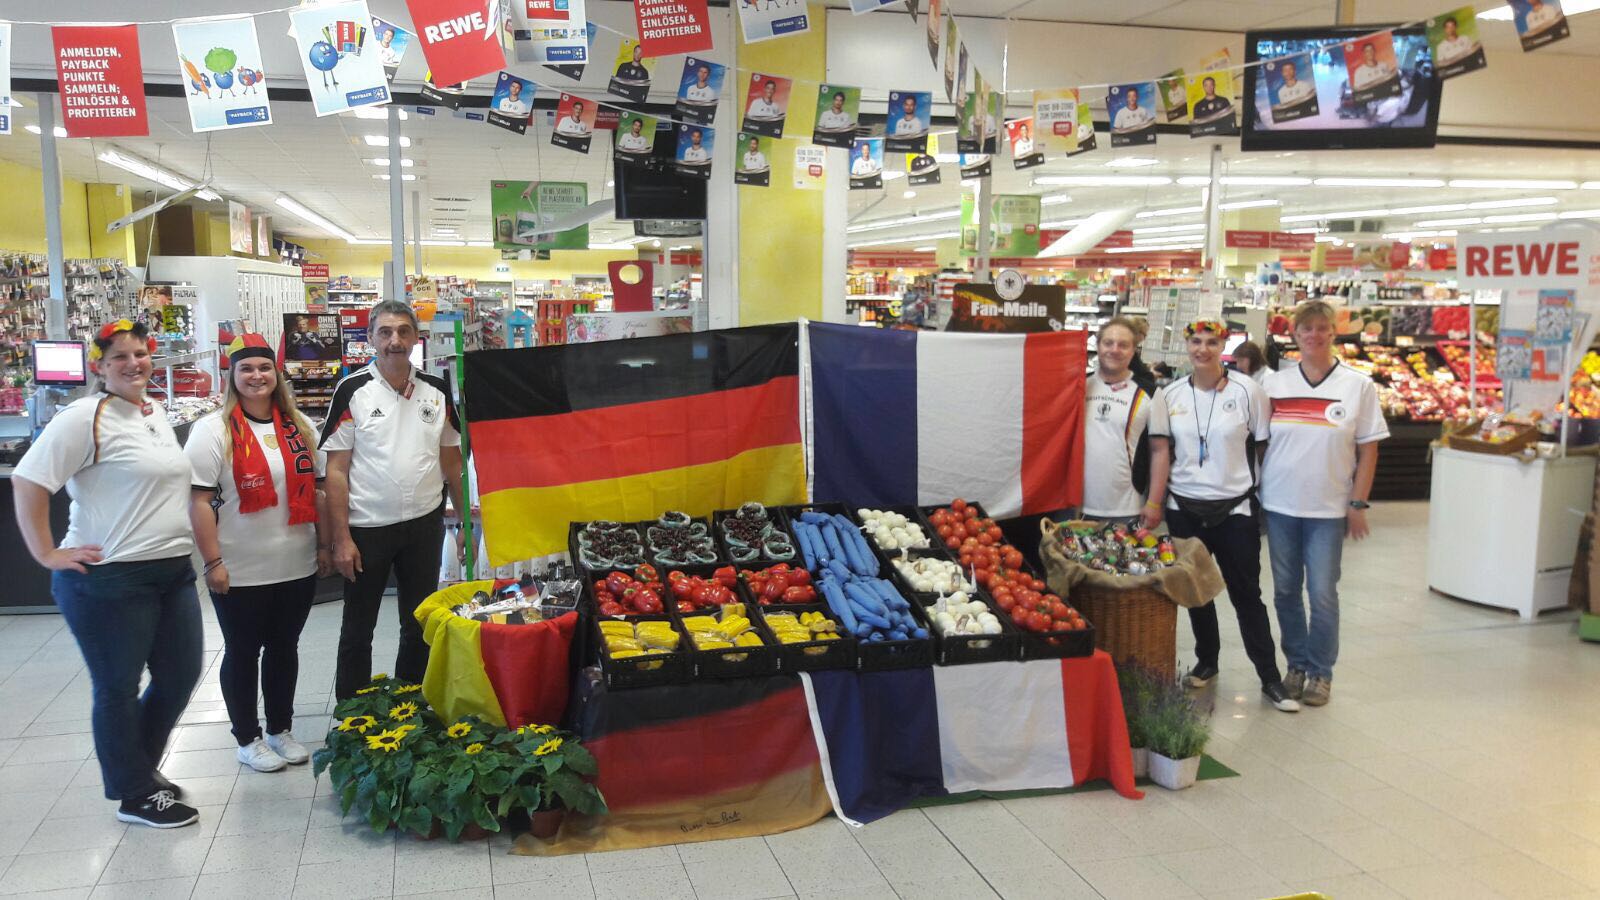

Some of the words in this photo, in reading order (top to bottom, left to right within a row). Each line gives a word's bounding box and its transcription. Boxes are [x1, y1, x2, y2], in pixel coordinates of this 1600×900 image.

[640, 4, 687, 17] SAMMELN;
[642, 15, 687, 28] EINLÖSEN
[688, 14, 696, 23] &
[424, 12, 486, 45] REWE
[643, 25, 702, 39] PROFITIEREN
[60, 47, 122, 58] ANMELDEN,
[61, 59, 110, 69] PAYBACK
[63, 72, 106, 82] PUNKTE
[65, 84, 120, 94] SAMMELN;
[66, 94, 119, 106] EINLÖSEN
[121, 95, 130, 105] &
[67, 107, 137, 118] PROFITIEREN
[1466, 241, 1580, 277] REWE
[971, 301, 1047, 317] Fan-Meile
